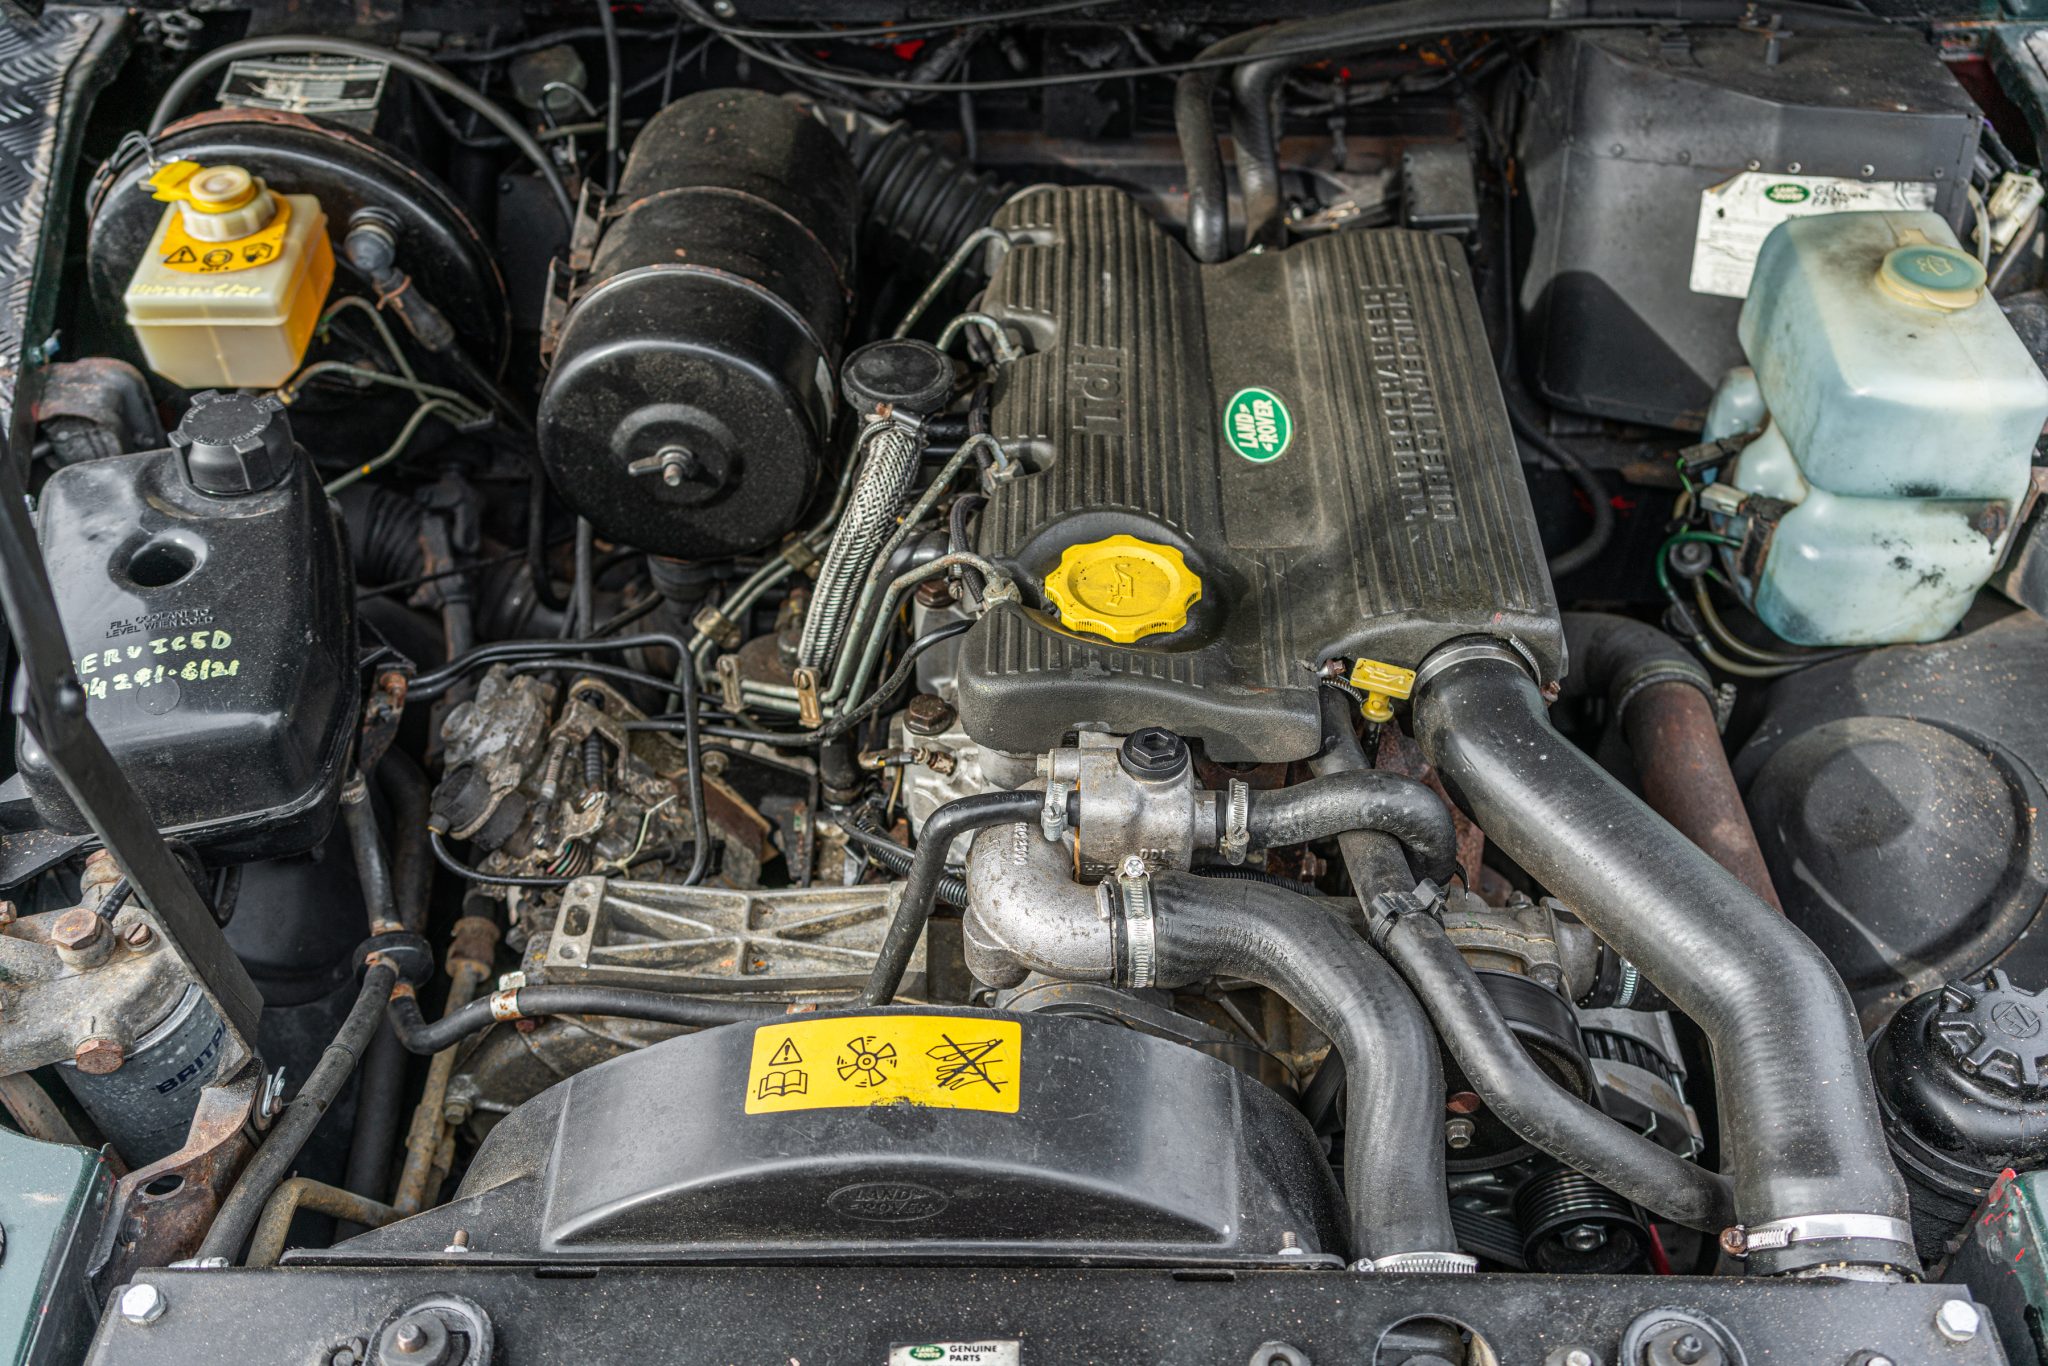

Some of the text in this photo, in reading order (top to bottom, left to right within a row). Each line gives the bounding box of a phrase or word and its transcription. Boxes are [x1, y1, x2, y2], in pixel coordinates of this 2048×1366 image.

[1234, 404, 1260, 449] LAND
[1252, 400, 1280, 452] ROVER
[105, 613, 215, 639] LEVEL WHEN COLD
[109, 608, 210, 630] FILL COOLANT TO
[155, 1020, 227, 1095] BRITP
[949, 1345, 998, 1353] GENUINE
[949, 1354, 981, 1362] PARTS
